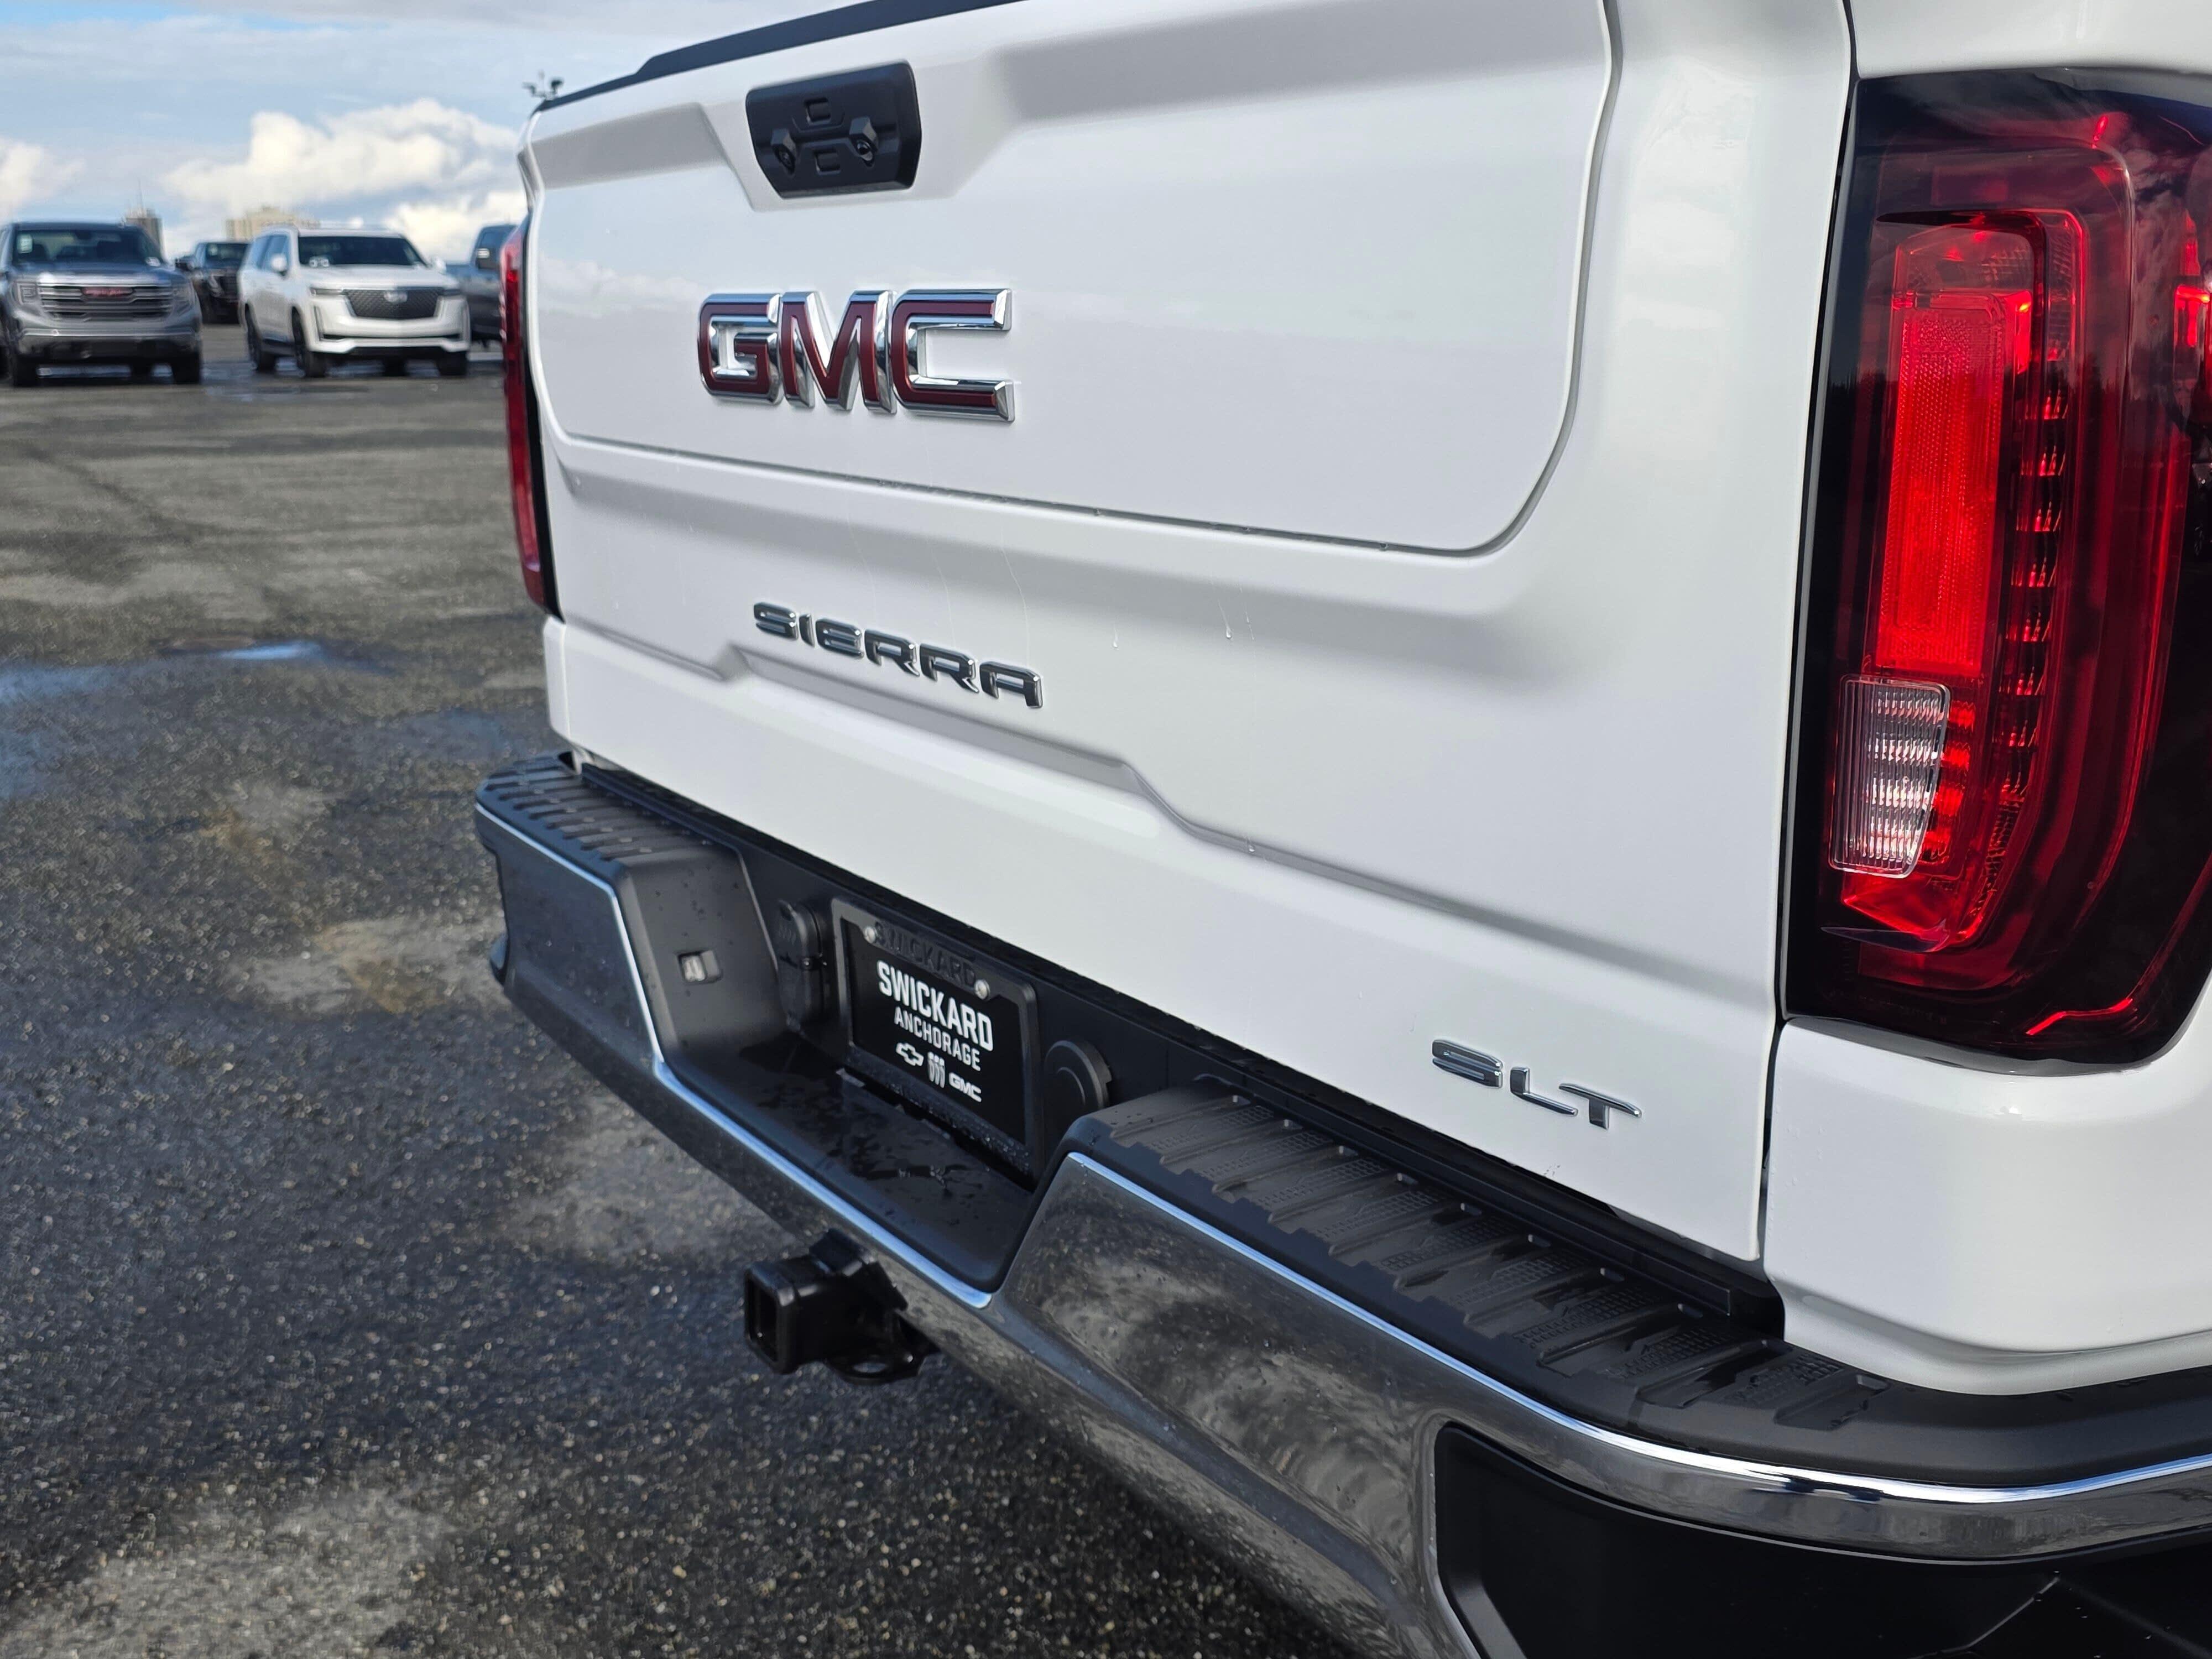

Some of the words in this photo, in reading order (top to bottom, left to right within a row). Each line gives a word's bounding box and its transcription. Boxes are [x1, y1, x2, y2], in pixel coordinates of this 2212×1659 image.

[698, 288, 1015, 422] GMC
[753, 602, 1043, 709] SIERRA
[877, 961, 994, 1051] SWICKARD
[894, 1007, 981, 1071] ANCHORAGE
[948, 1072, 982, 1102] GMC
[1432, 1039, 1642, 1130] SLT
